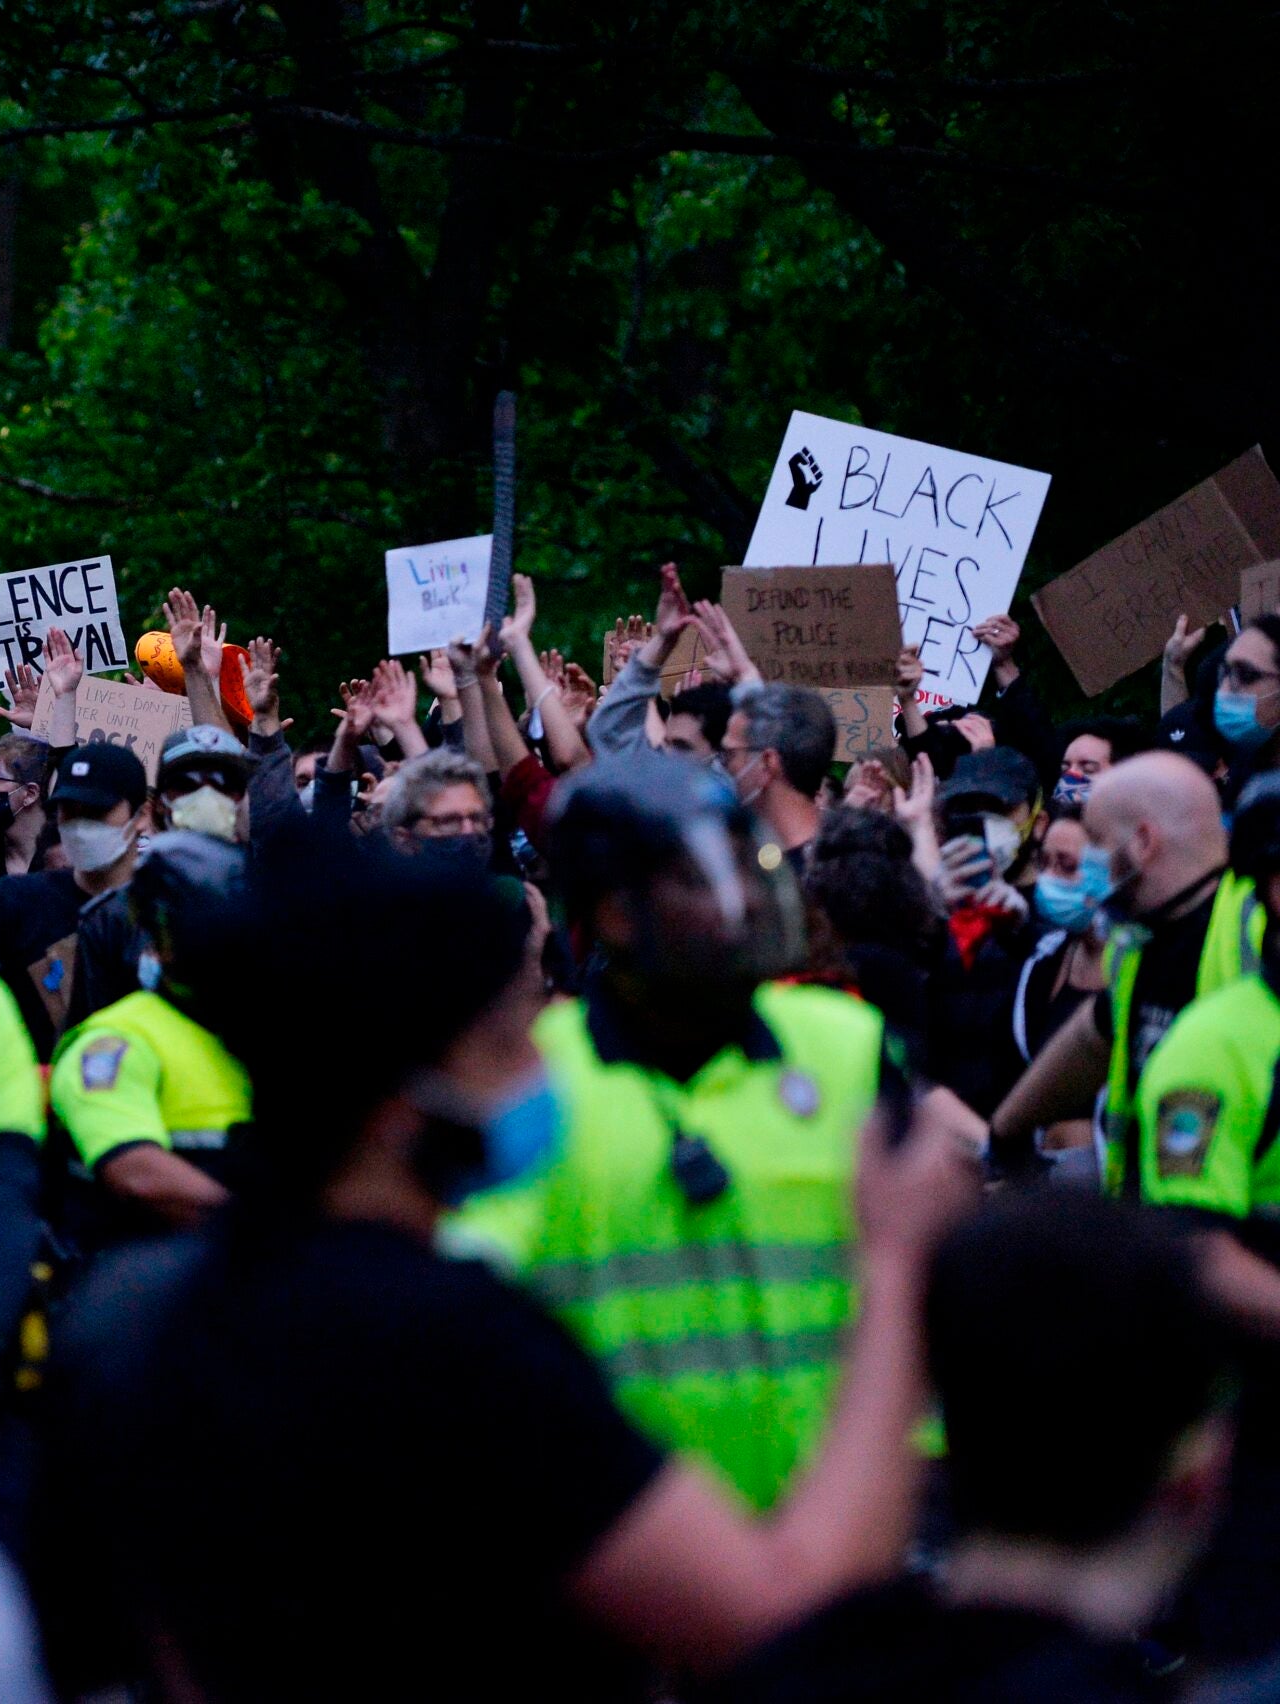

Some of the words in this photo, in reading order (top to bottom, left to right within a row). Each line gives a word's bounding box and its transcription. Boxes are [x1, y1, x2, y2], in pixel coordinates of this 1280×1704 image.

[839, 446, 1022, 549] BLACK
[814, 585, 855, 610] THE
[15, 622, 31, 637] IS
[772, 620, 839, 647] POLICE
[86, 687, 126, 709] LIVES
[106, 713, 141, 730] UNTIL
